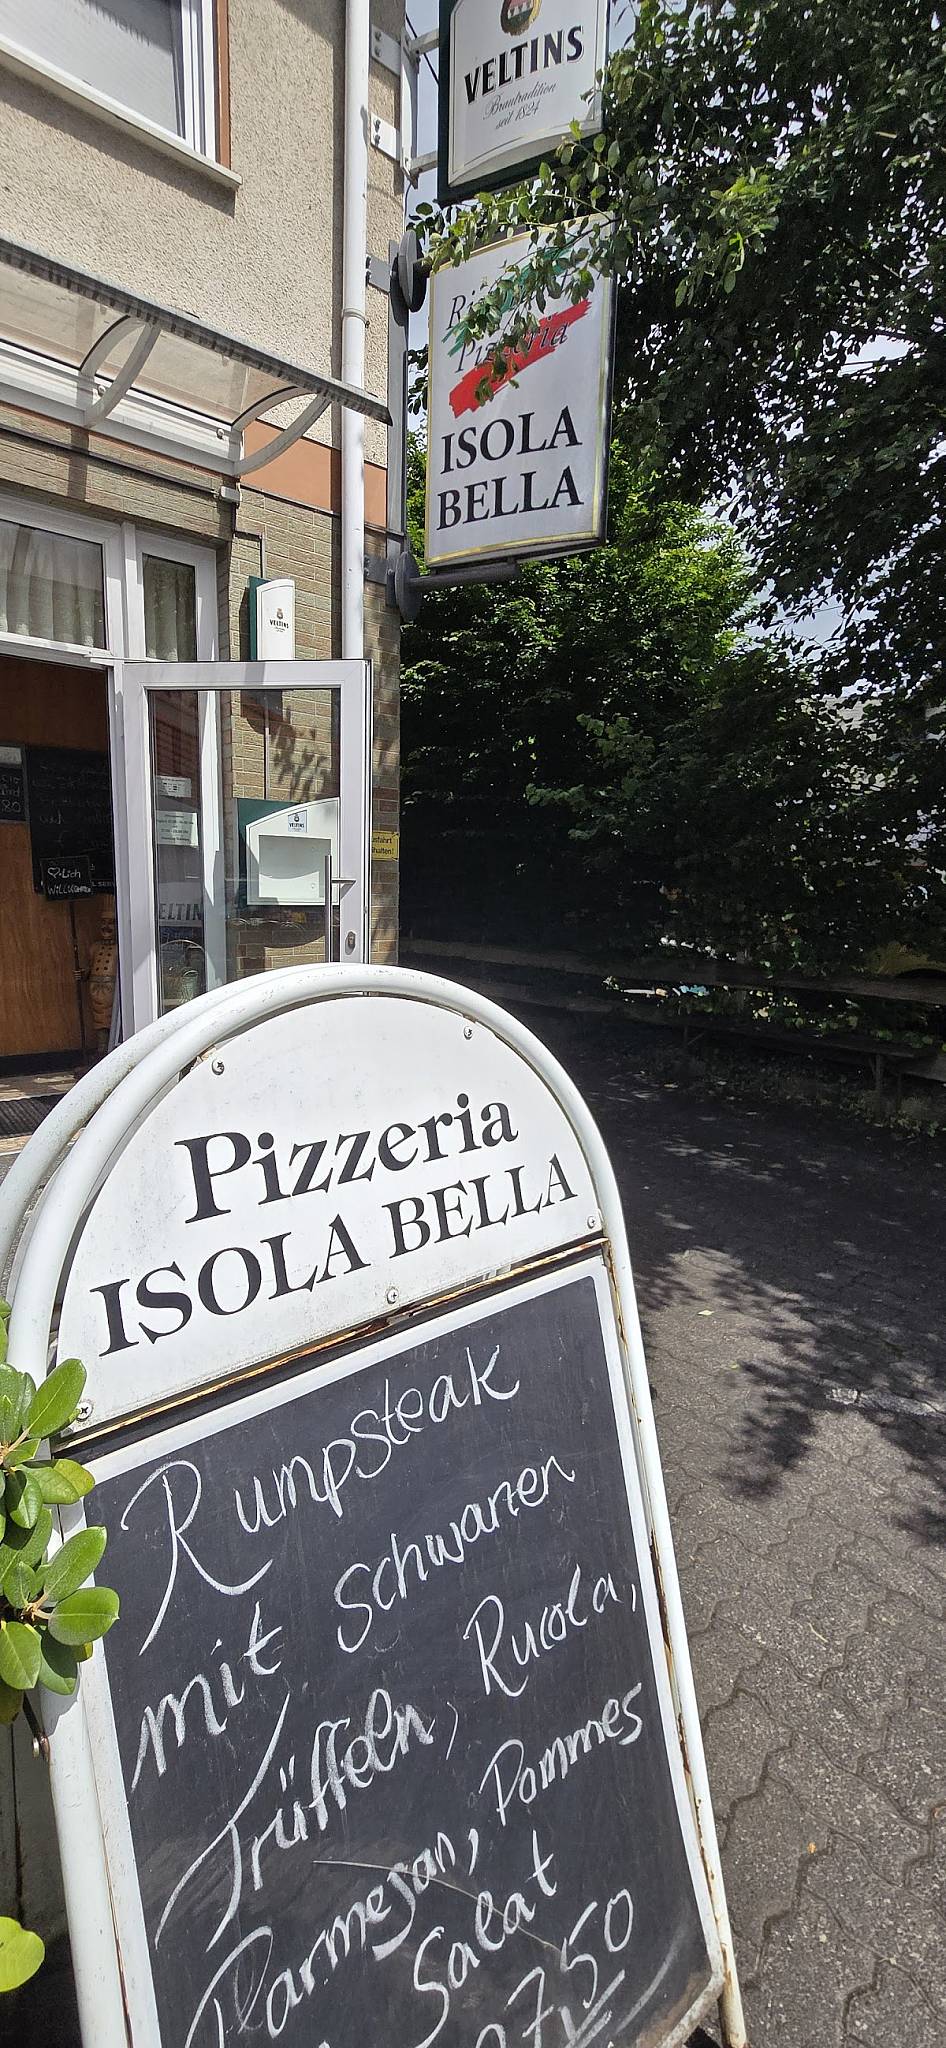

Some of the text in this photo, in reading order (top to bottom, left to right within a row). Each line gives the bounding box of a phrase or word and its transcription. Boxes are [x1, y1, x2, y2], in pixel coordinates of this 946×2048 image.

[464, 25, 584, 104] VELTINS
[495, 100, 540, 129] seit 1824
[454, 316, 568, 373] Pizria
[440, 405, 582, 474] ISOLA
[436, 465, 584, 531] BELLA
[174, 1093, 519, 1224] Pizzeria
[89, 1152, 578, 1358] ISOLA BELLA
[131, 1601, 283, 1794] mit
[478, 1683, 642, 1826] Pommes
[412, 1830, 558, 2048] Salat
